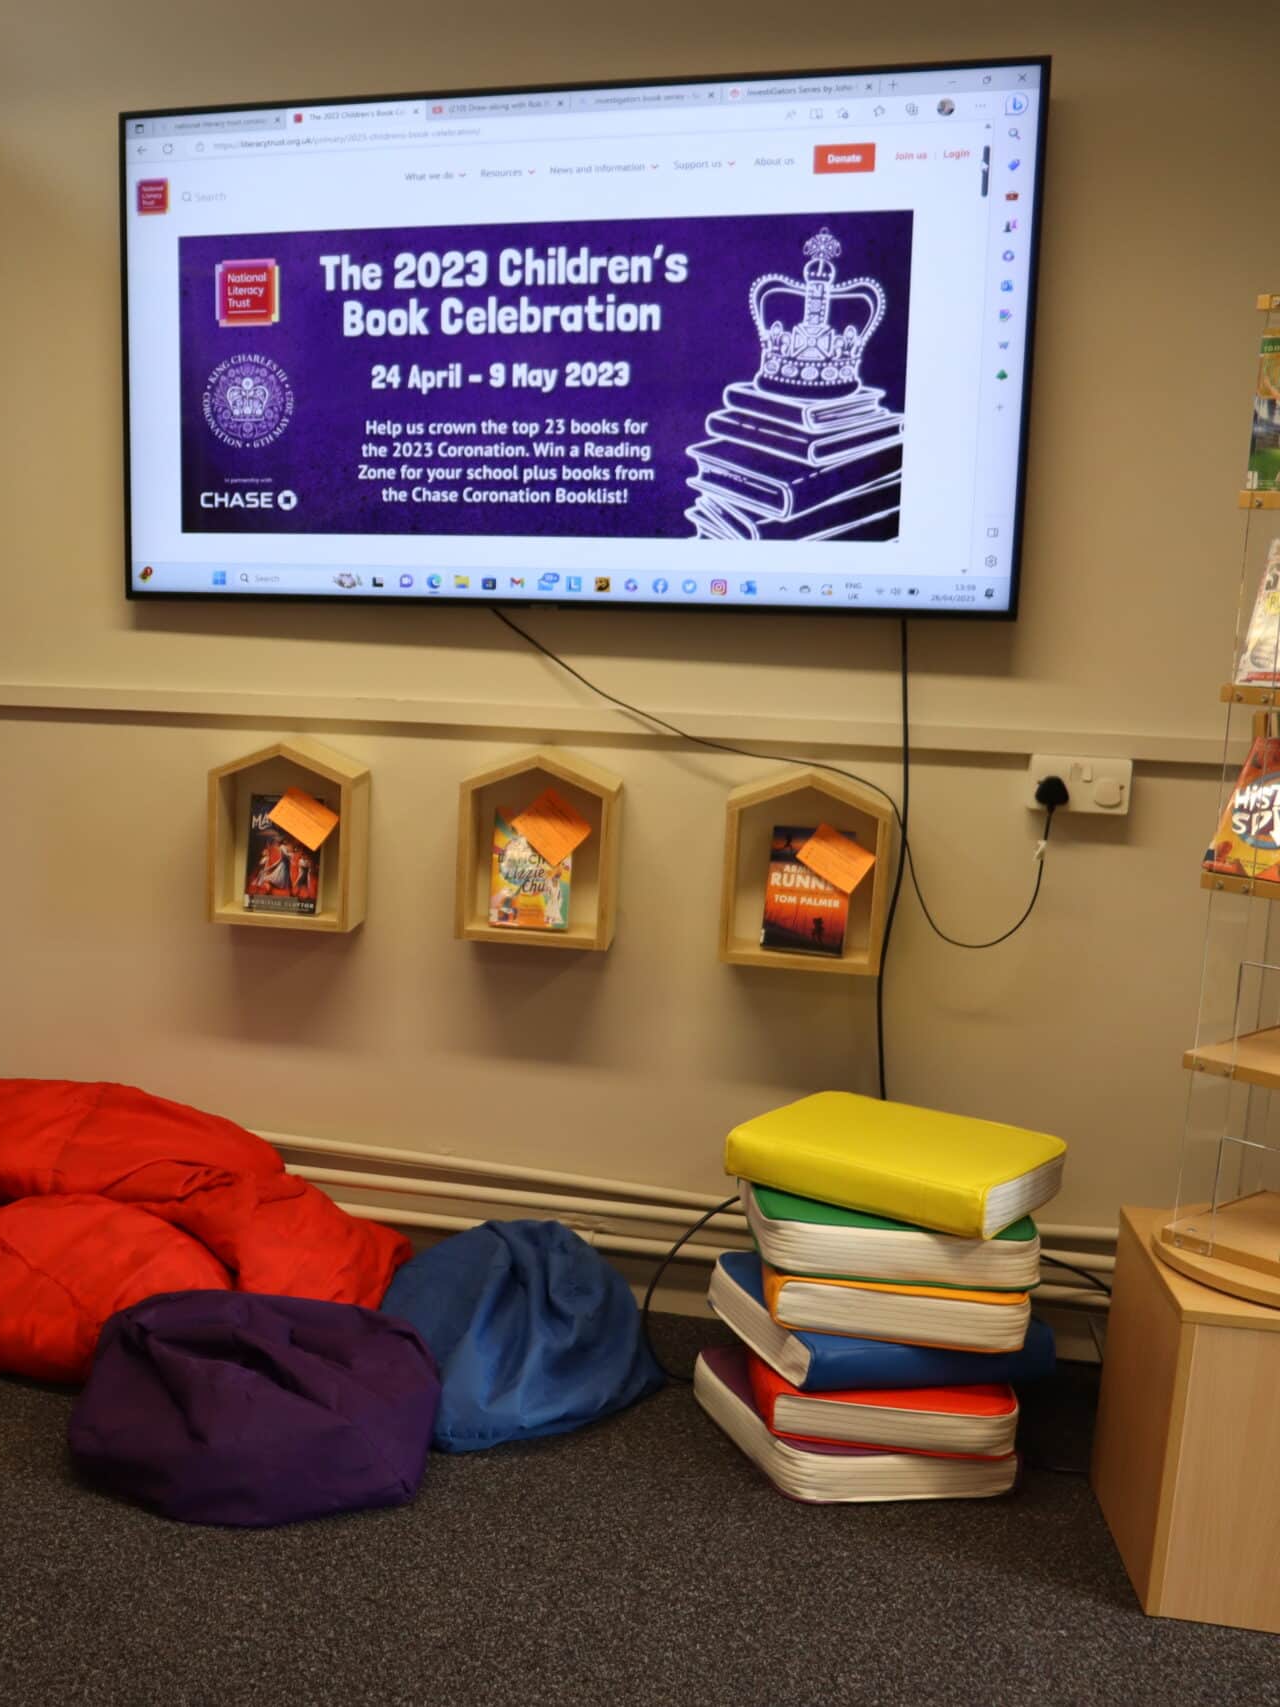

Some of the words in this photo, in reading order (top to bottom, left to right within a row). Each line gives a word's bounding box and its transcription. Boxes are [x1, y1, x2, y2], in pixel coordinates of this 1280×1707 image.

[754, 156, 781, 166] About
[784, 158, 795, 166] us
[827, 153, 862, 164] Donate
[895, 151, 914, 162] Join
[917, 152, 927, 160] us
[943, 148, 970, 160] Login
[550, 166, 572, 175] News
[576, 164, 592, 174] and
[595, 162, 646, 173] information
[673, 159, 707, 171] Support
[709, 160, 722, 168] us
[405, 172, 425, 182] What
[442, 171, 454, 180] do
[480, 168, 523, 178] Resources
[195, 192, 227, 202] Search
[319, 254, 382, 292] The
[394, 251, 489, 289] 2023
[499, 244, 689, 287] Children's
[227, 271, 267, 283] National
[227, 286, 264, 297] Literacy
[228, 298, 251, 308] Trust
[343, 298, 430, 337] Book
[440, 294, 662, 336] Celebration
[208, 360, 230, 384] KING
[231, 354, 278, 371] CHARLES
[370, 364, 401, 389] 24
[407, 362, 462, 395] April
[489, 362, 505, 388] 9
[511, 362, 558, 393] May
[565, 361, 631, 388] 2023
[202, 392, 242, 448] CORONATION
[365, 419, 402, 438] Help
[406, 421, 424, 435] us
[428, 421, 477, 435] crown
[481, 419, 508, 435] the
[512, 420, 539, 438] top
[545, 419, 566, 434] 23
[570, 418, 619, 435] books
[623, 418, 648, 435] for
[361, 442, 388, 458] the
[392, 442, 433, 458] 2023
[437, 442, 530, 458] Coronation.
[533, 442, 564, 457] Win
[569, 445, 579, 457] a
[584, 442, 652, 461] Reading
[358, 465, 396, 480] Zone
[400, 464, 423, 480] for
[427, 468, 462, 483] your
[466, 464, 518, 480] school
[523, 464, 557, 484] plus
[562, 464, 610, 481] books
[614, 464, 655, 481] from
[200, 491, 274, 508] CHASE
[381, 487, 408, 502] the
[412, 486, 458, 502] Chase
[463, 486, 551, 503] Coronation
[555, 488, 628, 503] Booklist!
[770, 870, 833, 892] RUNN
[774, 893, 797, 905] TOM
[799, 895, 841, 909] PALMER
